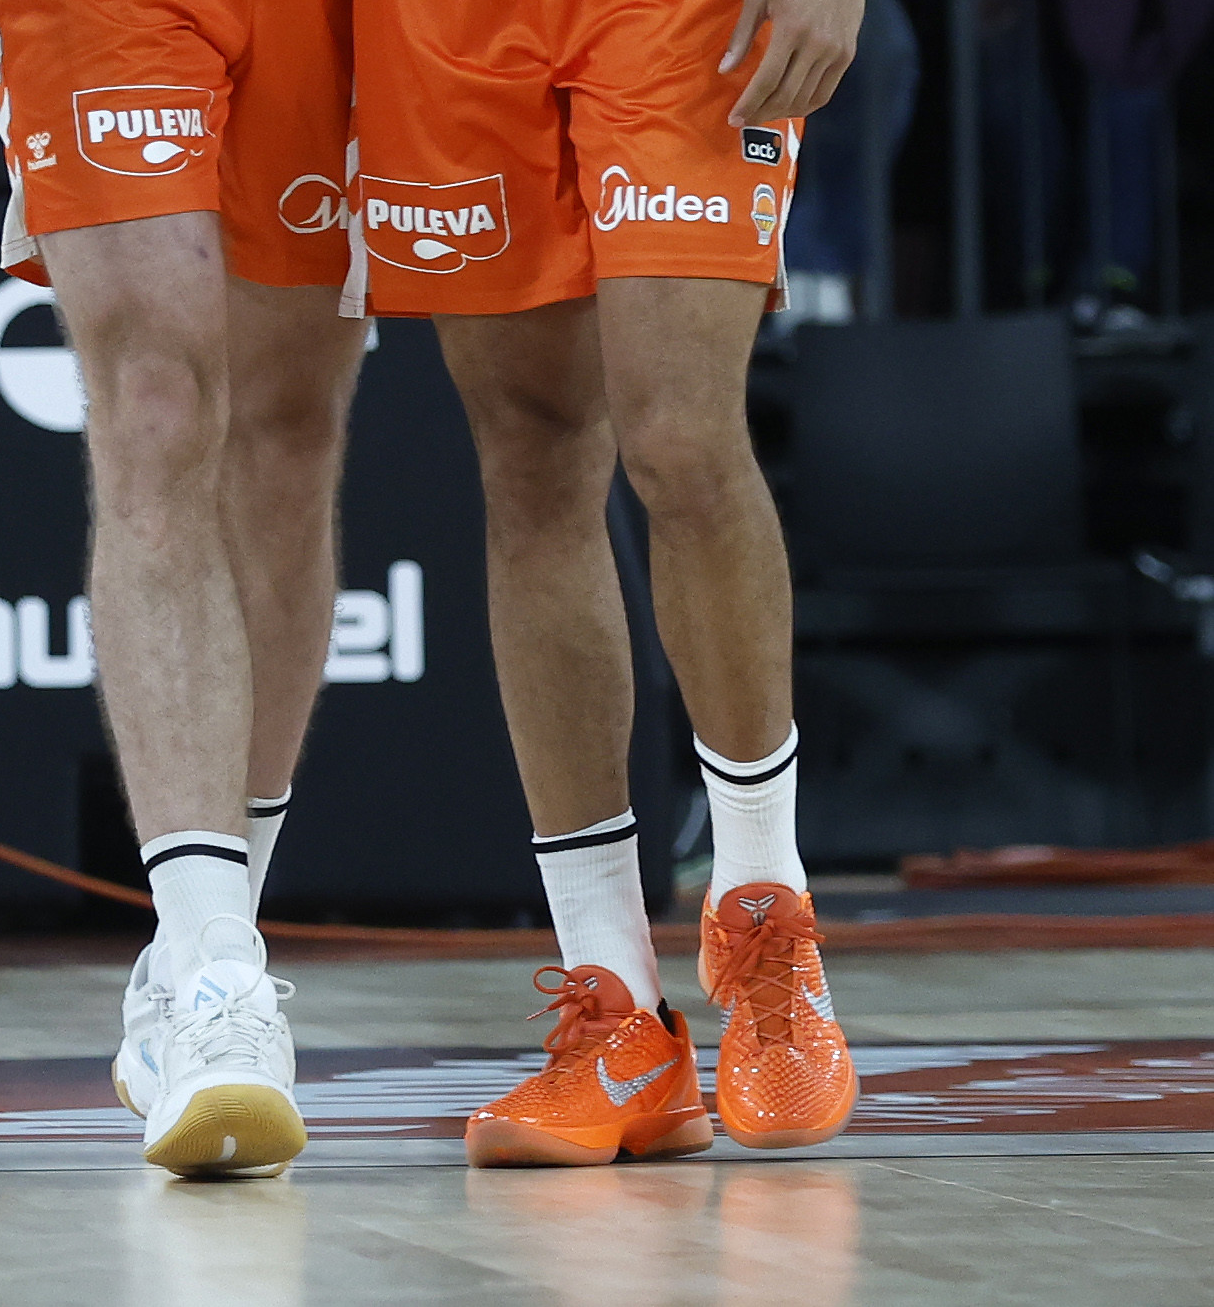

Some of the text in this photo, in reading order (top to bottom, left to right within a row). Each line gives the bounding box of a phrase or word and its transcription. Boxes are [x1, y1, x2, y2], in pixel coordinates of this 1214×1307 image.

[87, 108, 204, 143] PULEVA
[367, 198, 496, 236] PULEVA
[594, 165, 730, 232] Midea
